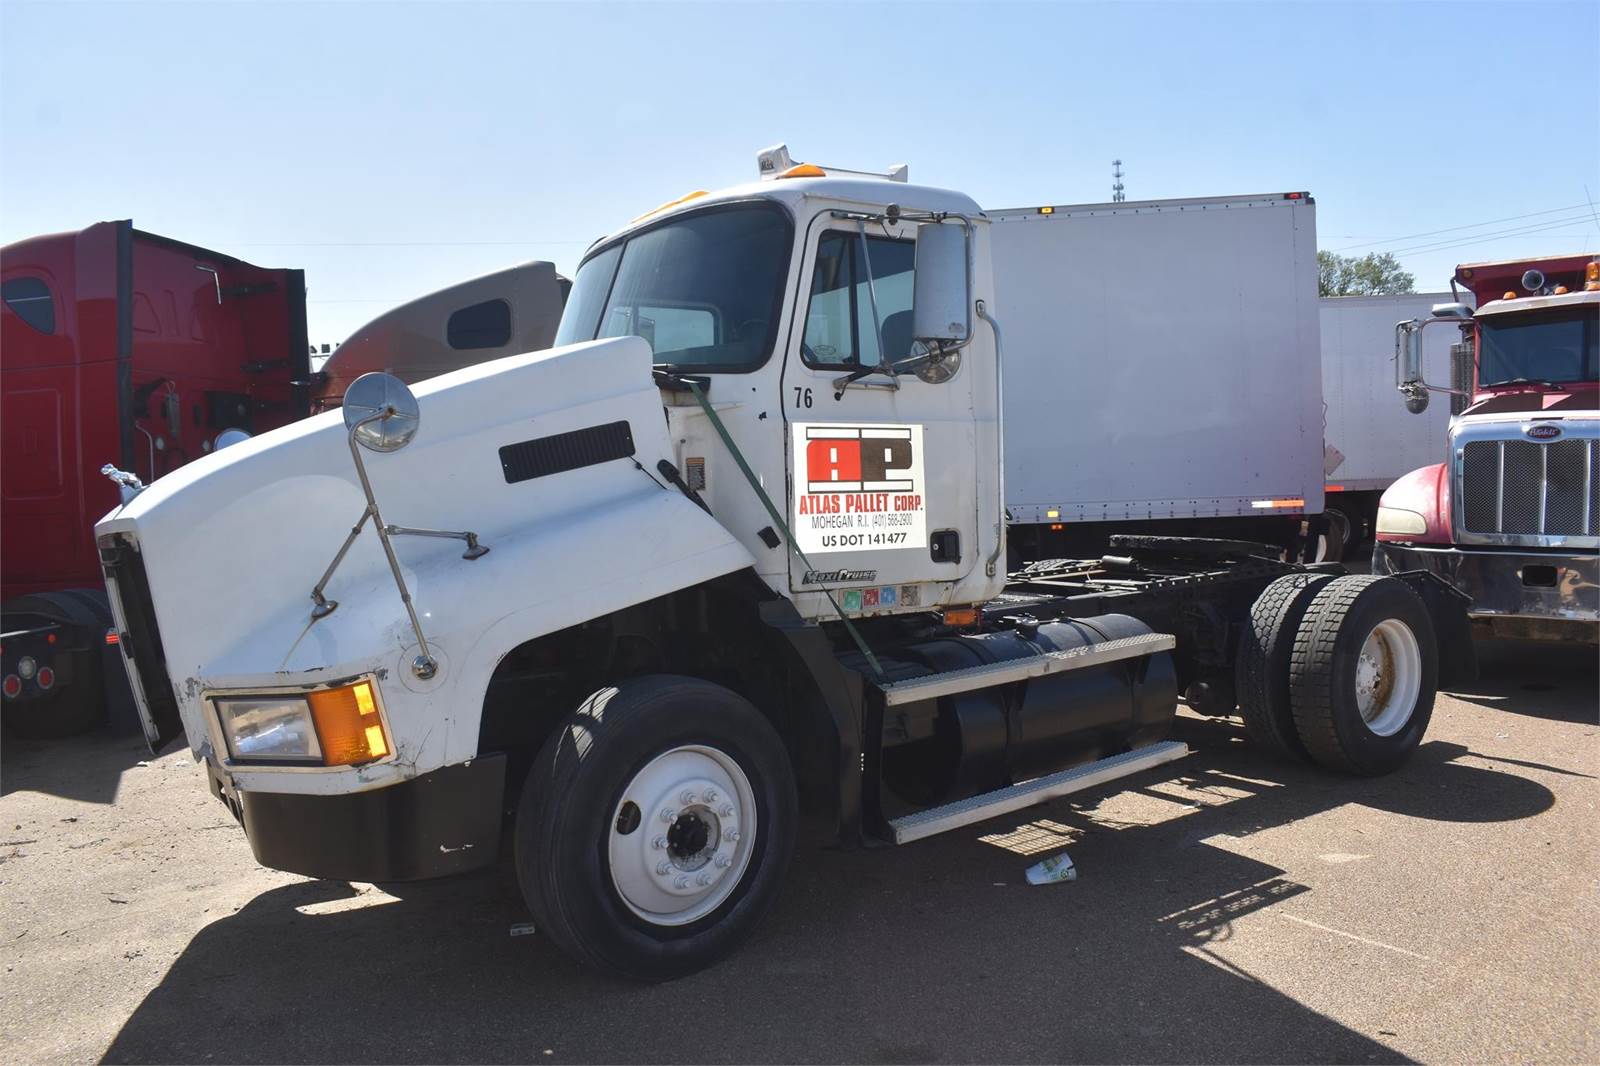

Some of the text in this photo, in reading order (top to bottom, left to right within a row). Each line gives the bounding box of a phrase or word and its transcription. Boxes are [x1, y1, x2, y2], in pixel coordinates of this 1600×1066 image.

[794, 387, 813, 409] 76
[799, 493, 923, 514] ATLAS PALLET CORP.
[811, 515, 853, 529] MOHEGAN
[822, 532, 907, 547] US DOT 141477
